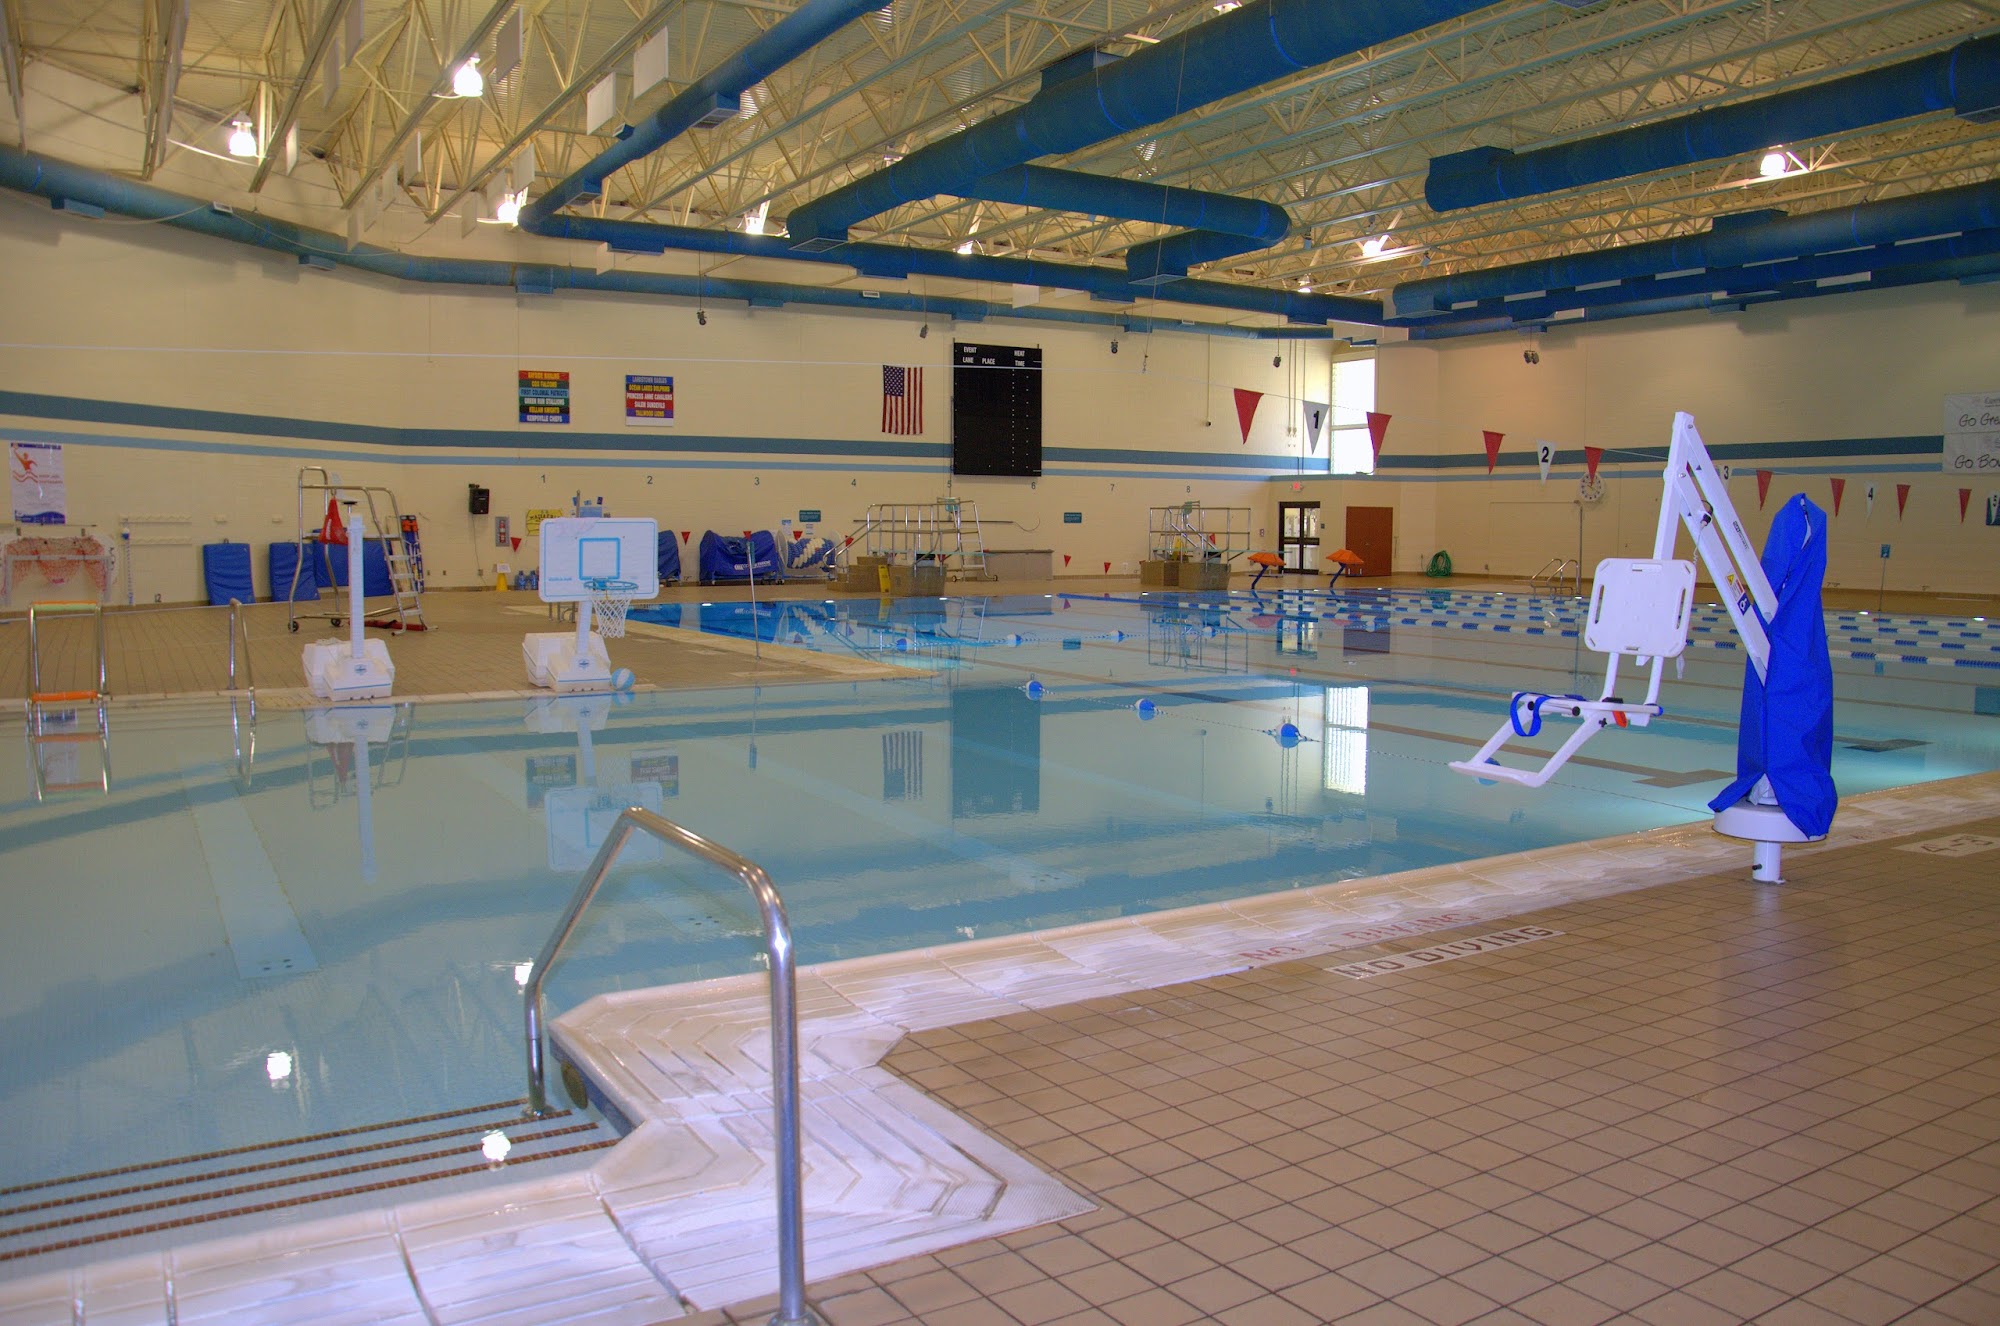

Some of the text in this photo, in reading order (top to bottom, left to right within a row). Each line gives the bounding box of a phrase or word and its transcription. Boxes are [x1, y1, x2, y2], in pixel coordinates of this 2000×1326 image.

[963, 346, 977, 354] EVENT
[962, 356, 995, 365] LANE PLACE
[1313, 410, 1320, 429] 1
[1959, 412, 2000, 428] Go Gre
[1541, 446, 1549, 463] 2
[1954, 453, 2000, 469] Go Bo
[1723, 465, 1729, 480] 3
[541, 474, 546, 484] 1
[646, 475, 653, 485] 2
[754, 476, 760, 486] 3
[851, 478, 857, 487] 4
[947, 480, 952, 489] 5
[1031, 481, 1036, 490] 6
[1110, 483, 1115, 491] 7
[1186, 485, 1191, 494] 8
[1868, 487, 1873, 501] 4
[1333, 927, 1554, 979] NO DIVING
